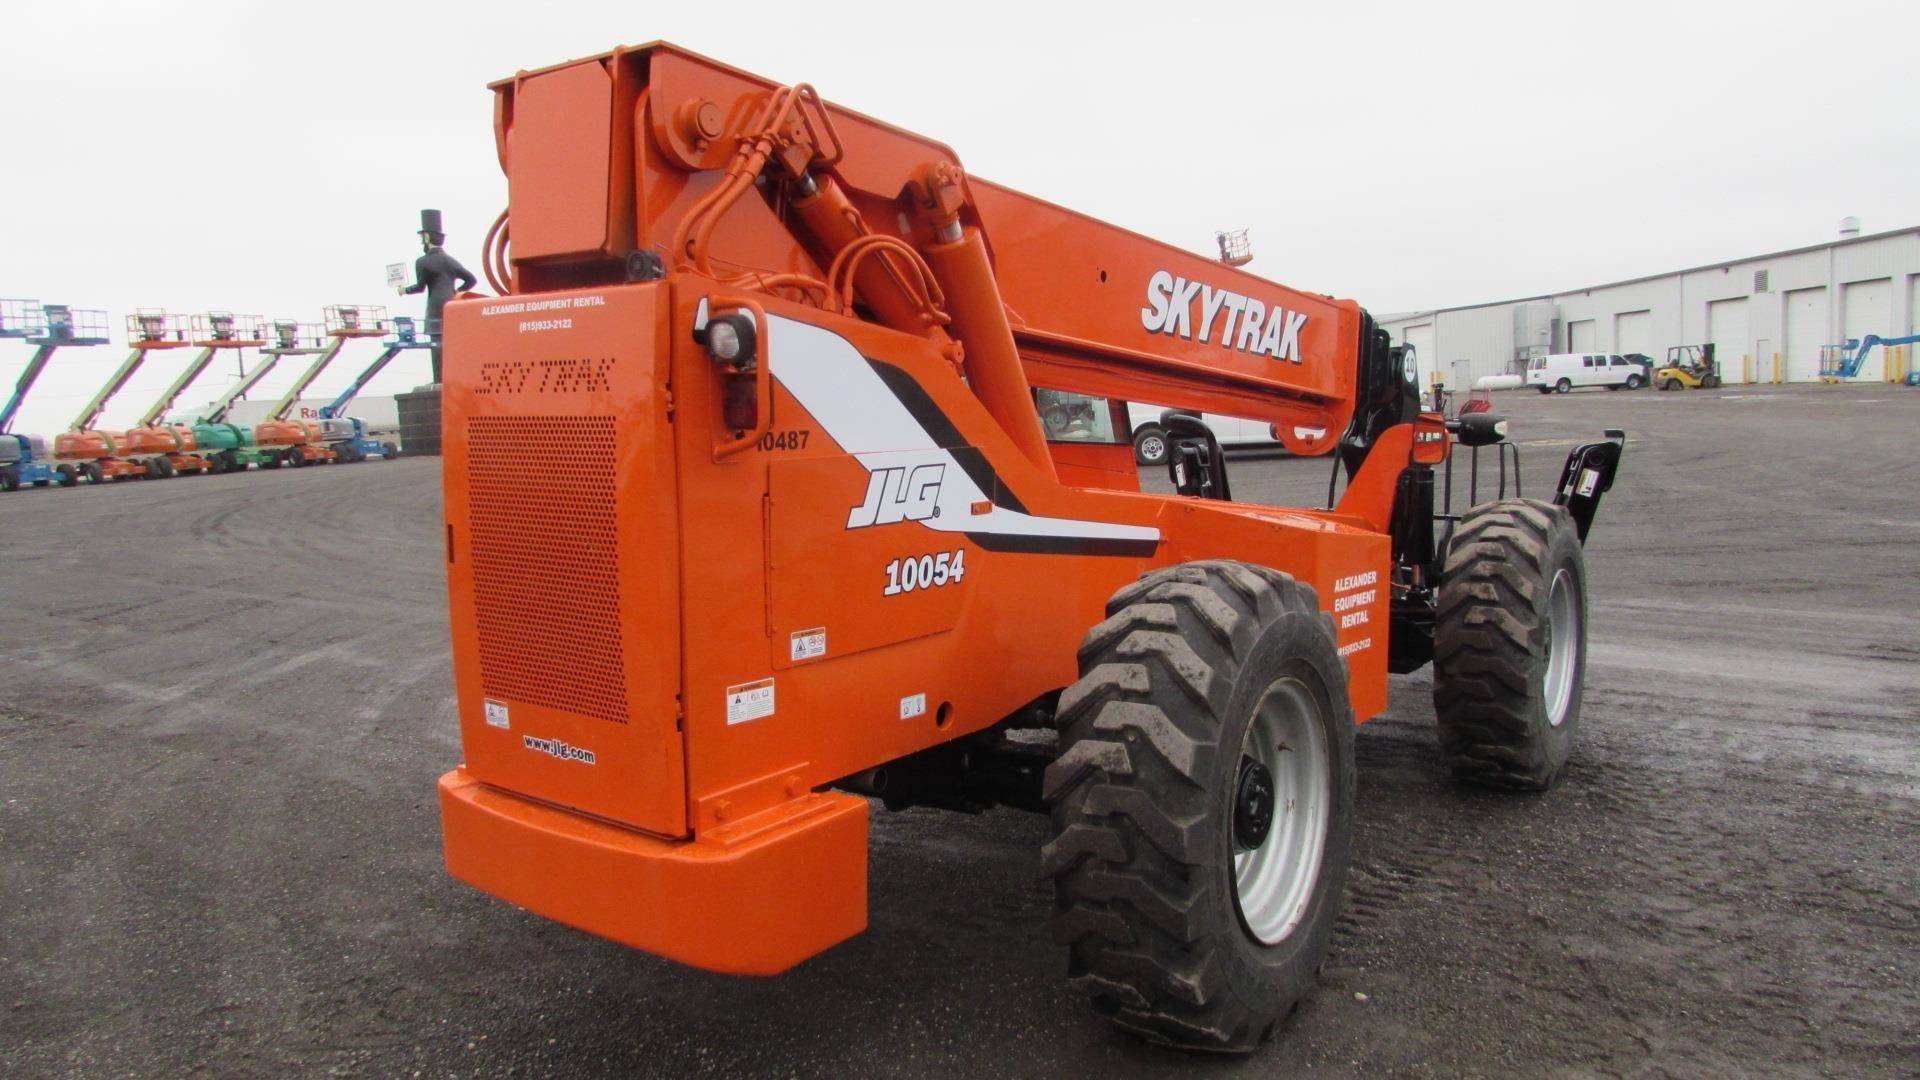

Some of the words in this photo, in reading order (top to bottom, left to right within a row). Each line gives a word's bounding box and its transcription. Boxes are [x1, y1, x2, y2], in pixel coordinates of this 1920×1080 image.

[482, 304, 525, 315] ALEXANDER
[526, 300, 571, 311] EQUIPMENT
[574, 297, 605, 307] RENTAL
[1141, 270, 1308, 365] SKYTRAK
[519, 319, 572, 333] (815)933-2122
[845, 463, 946, 530] JLG
[883, 548, 965, 597] 10054
[1334, 571, 1377, 592] ALEXANDER
[1334, 589, 1376, 612] EQUIPMENT
[1341, 610, 1369, 628] RENTAL
[523, 735, 596, 764] www.jlg.com
